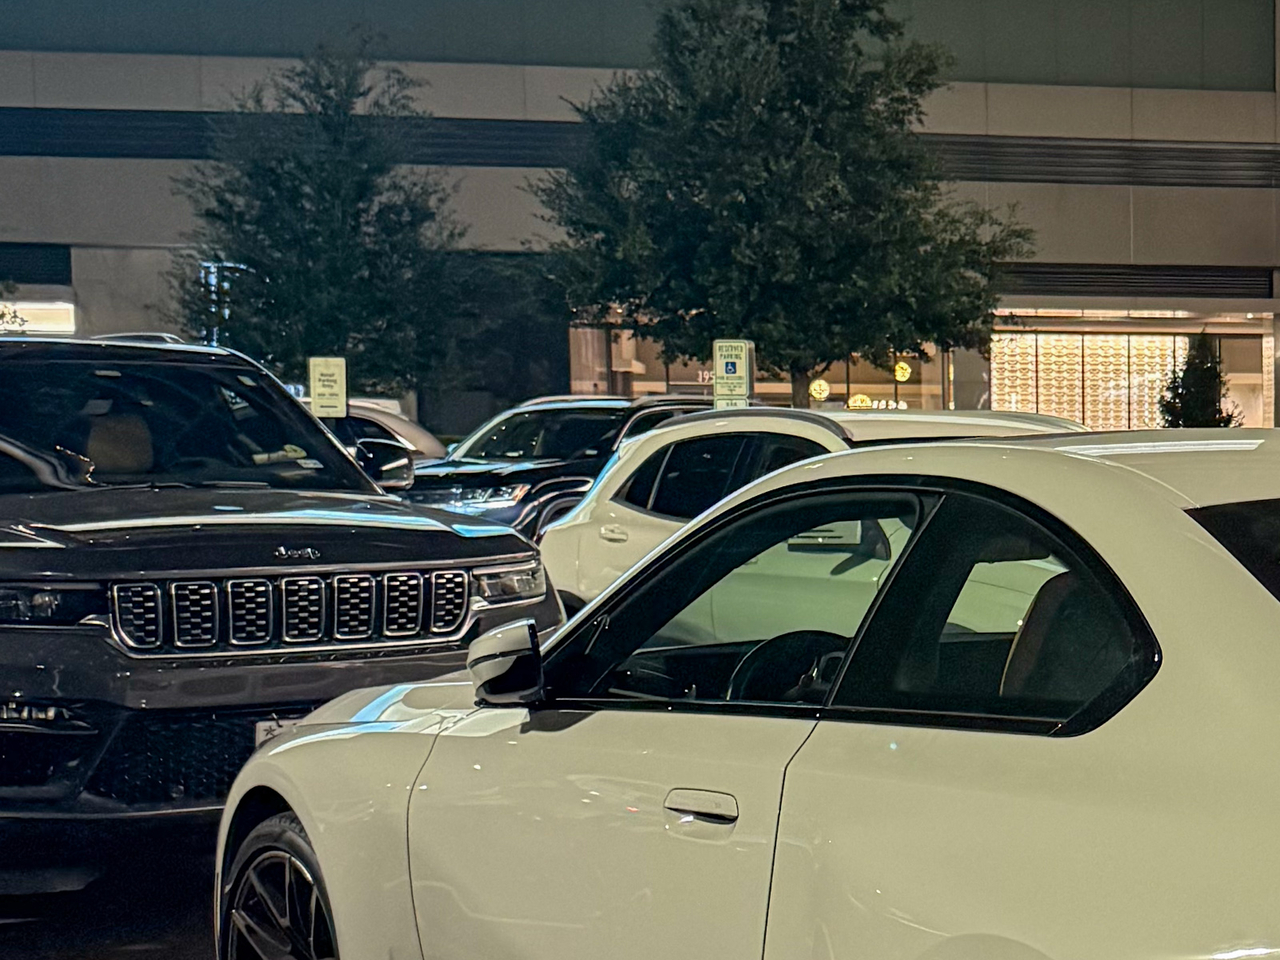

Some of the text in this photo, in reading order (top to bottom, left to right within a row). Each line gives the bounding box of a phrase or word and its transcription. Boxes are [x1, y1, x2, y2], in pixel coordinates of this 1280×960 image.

[718, 344, 743, 353] RESERVED
[719, 353, 742, 361] PARKING
[273, 546, 321, 560] Jeep
